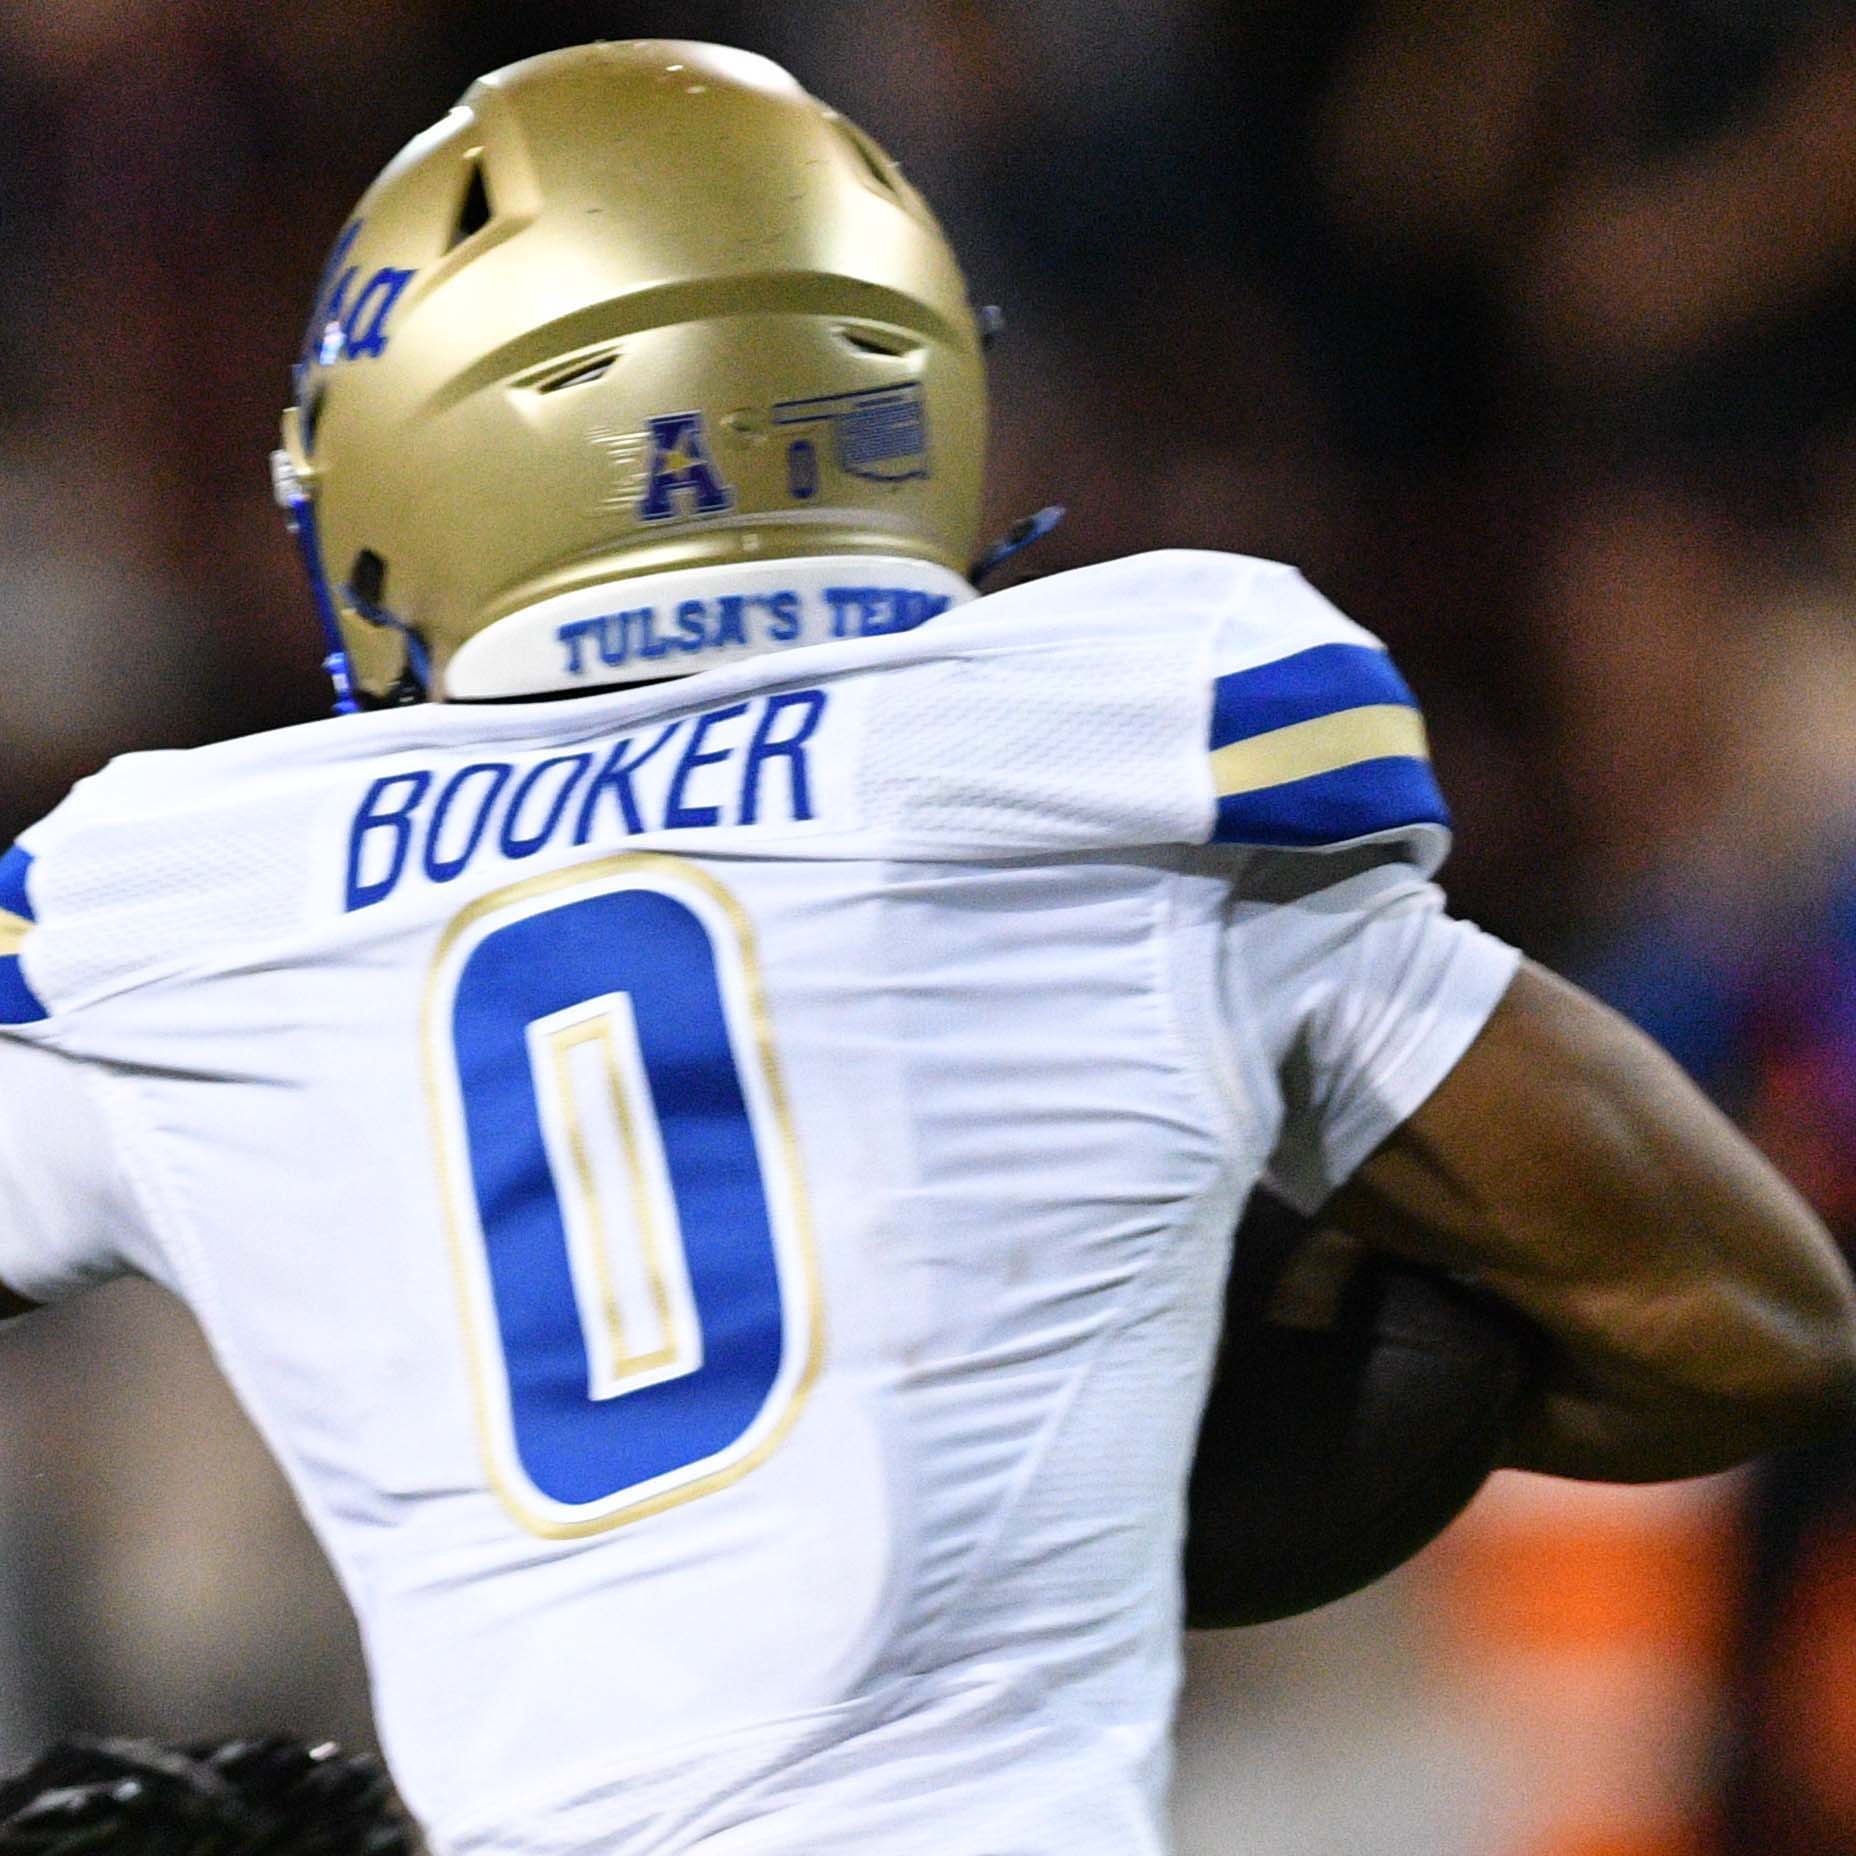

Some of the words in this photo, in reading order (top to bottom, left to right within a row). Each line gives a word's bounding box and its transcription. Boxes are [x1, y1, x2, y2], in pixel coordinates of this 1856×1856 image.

[636, 410, 736, 524] A
[557, 589, 799, 675] TULSA'S
[345, 689, 829, 912] BOOKER
[422, 850, 828, 1540] 0
